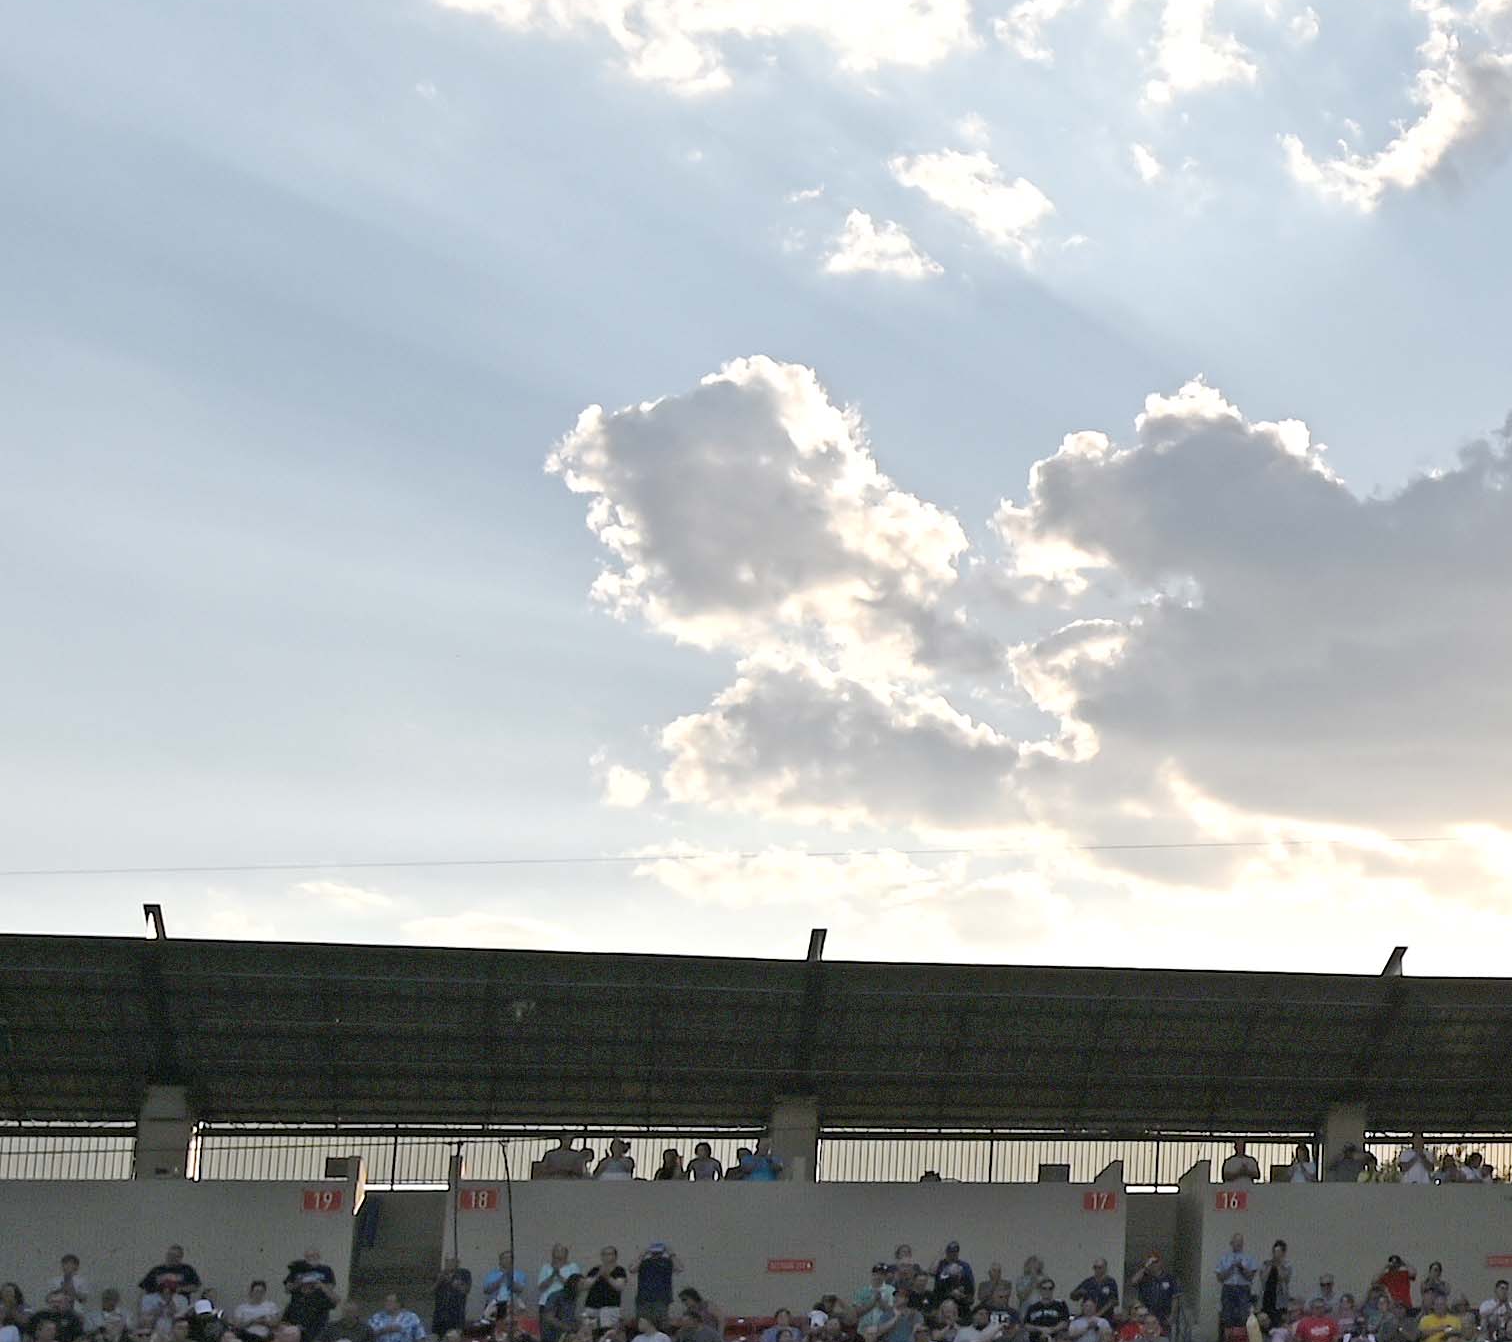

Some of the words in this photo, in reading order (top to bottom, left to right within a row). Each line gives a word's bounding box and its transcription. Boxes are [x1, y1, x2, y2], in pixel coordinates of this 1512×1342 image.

[314, 1190, 333, 1209] 19
[470, 1190, 487, 1209] 18
[1092, 1193, 1108, 1209] 17
[1222, 1192, 1239, 1209] 16
